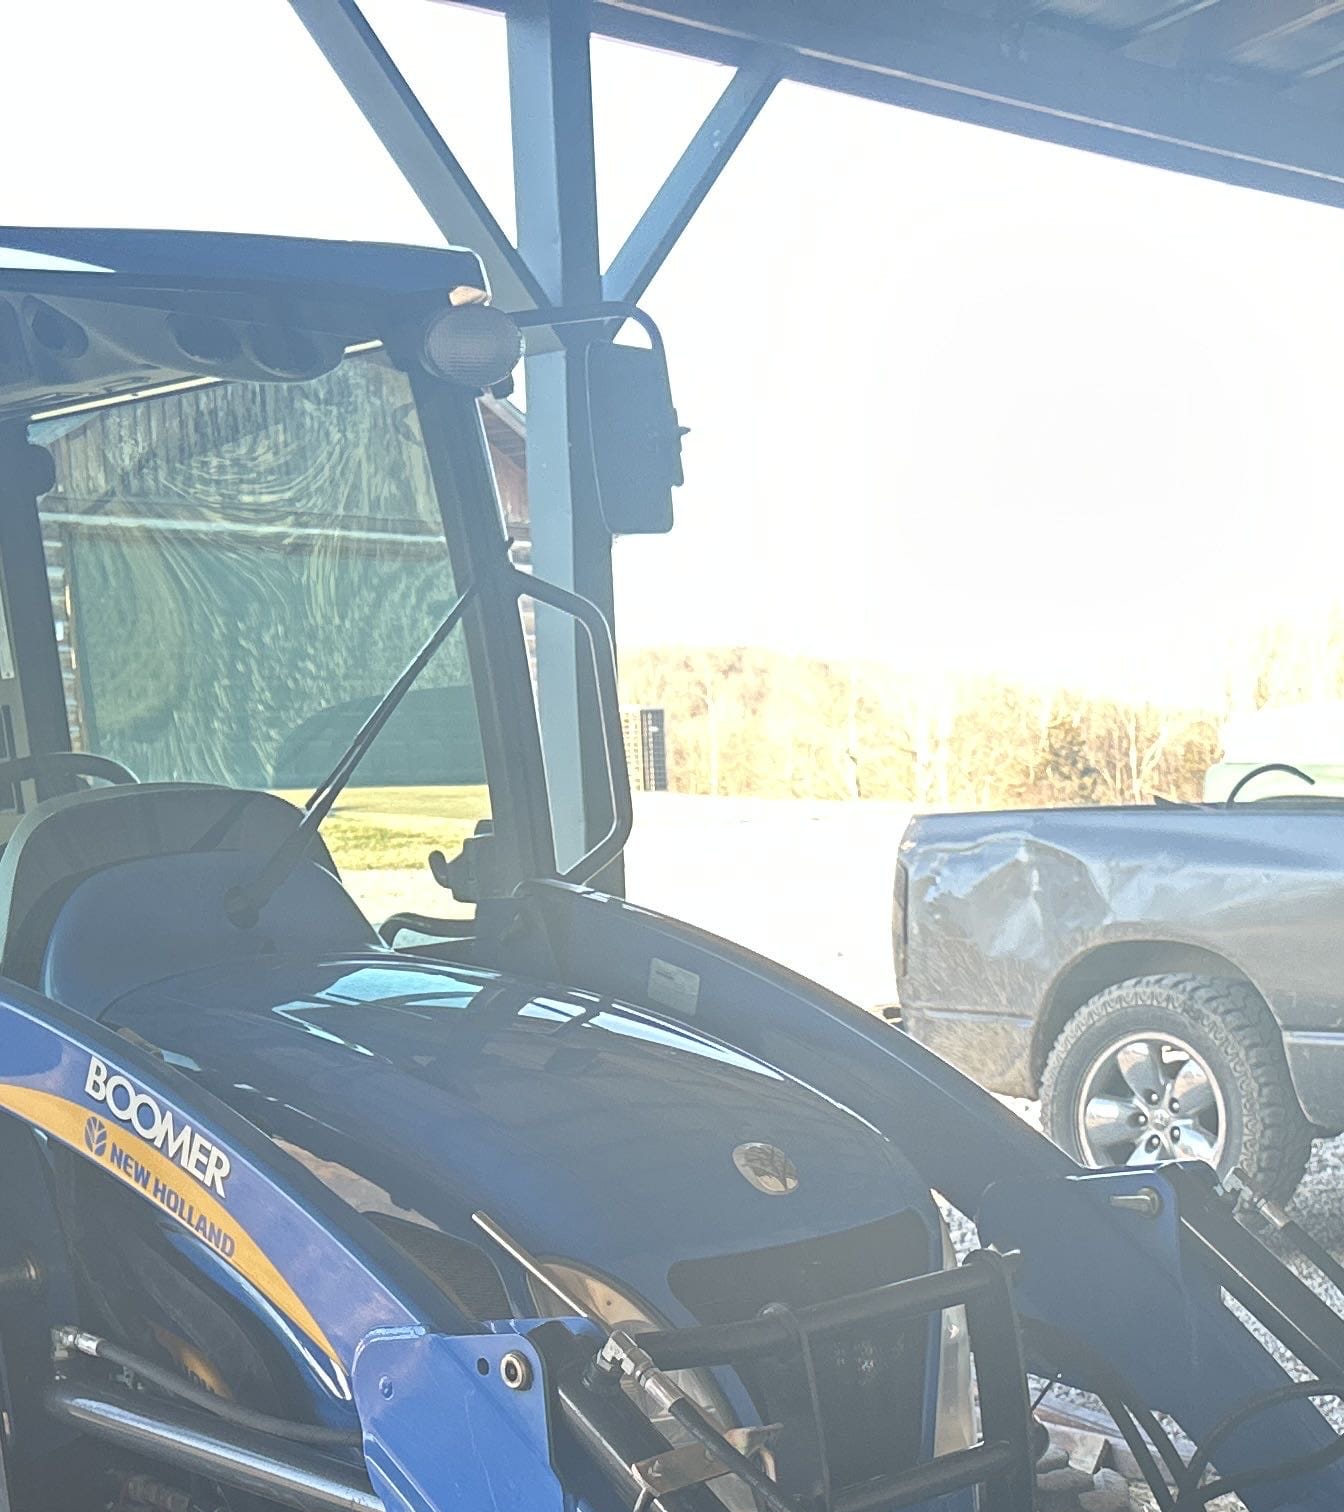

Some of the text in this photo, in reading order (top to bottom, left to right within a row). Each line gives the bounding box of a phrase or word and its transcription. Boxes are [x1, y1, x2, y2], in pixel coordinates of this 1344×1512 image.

[84, 1055, 231, 1199] BOOMER
[110, 1142, 236, 1259] NEW HOLLAND
